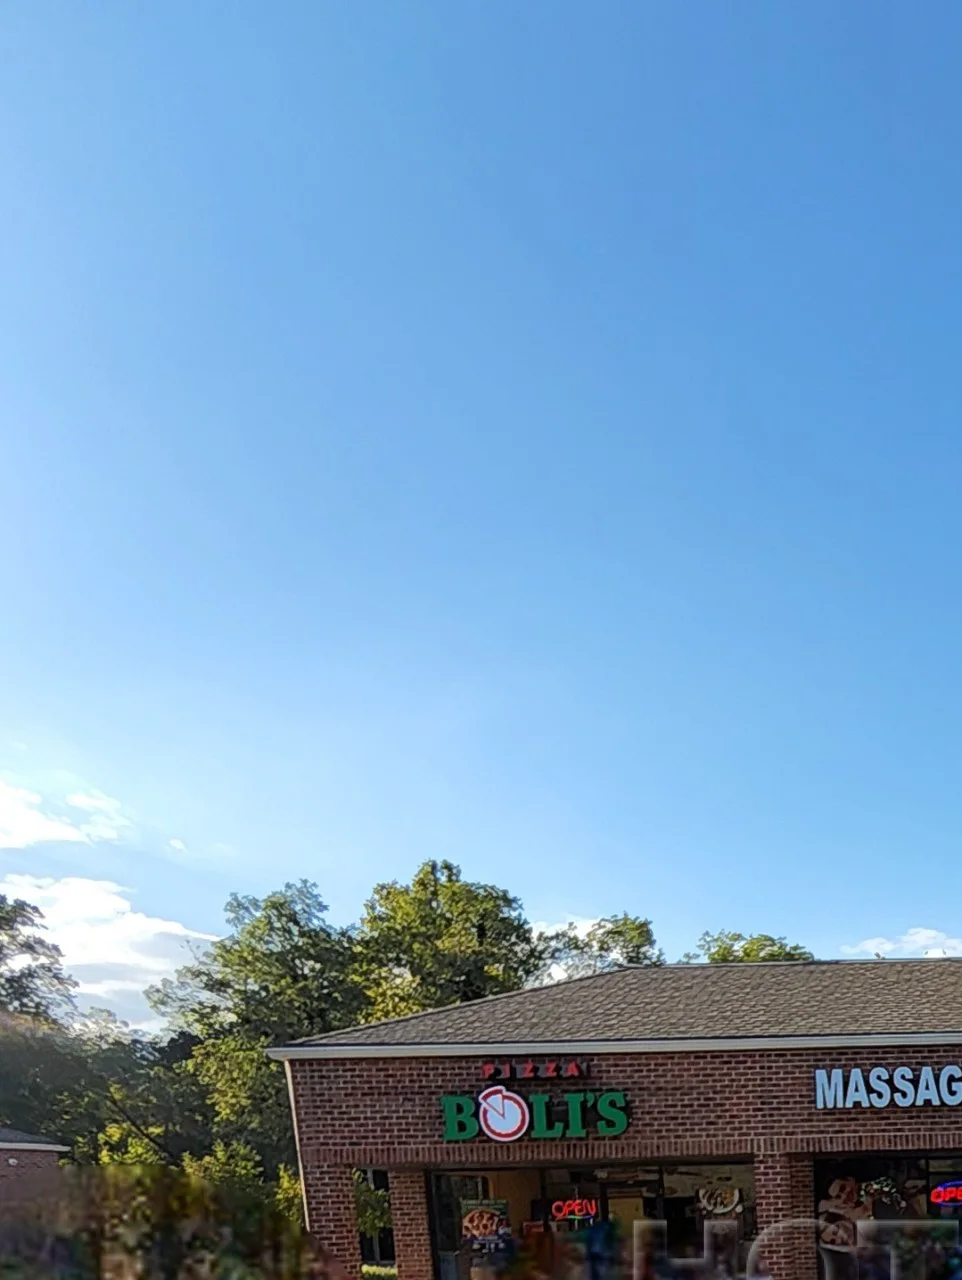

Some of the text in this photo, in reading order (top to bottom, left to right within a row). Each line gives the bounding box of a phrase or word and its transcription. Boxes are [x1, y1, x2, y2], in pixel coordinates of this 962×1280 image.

[481, 1061, 580, 1079] PIZZA
[442, 1086, 630, 1142] BOLI'S
[551, 1198, 597, 1219] OPEN
